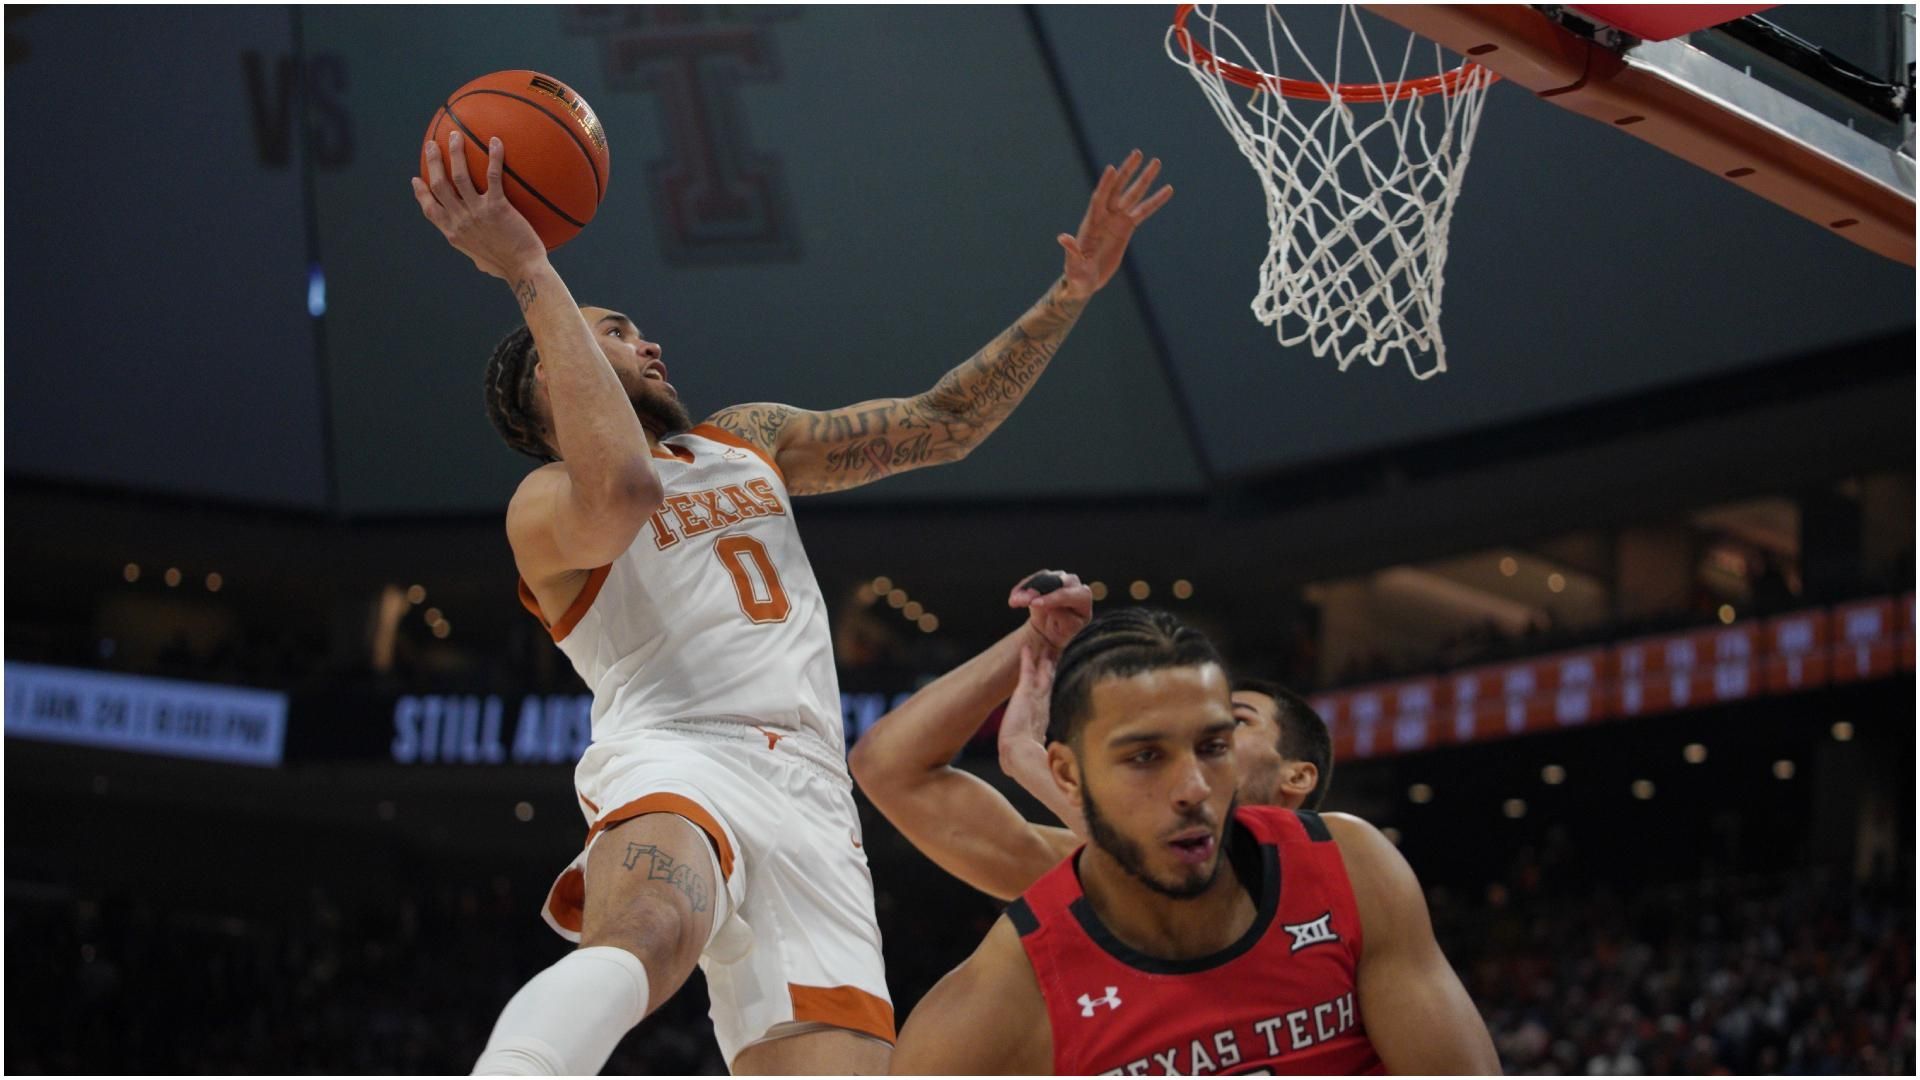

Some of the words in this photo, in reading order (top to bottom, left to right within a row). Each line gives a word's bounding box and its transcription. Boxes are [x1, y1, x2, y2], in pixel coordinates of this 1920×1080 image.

[649, 477, 787, 551] TEXAS
[713, 533, 792, 625] 0
[391, 694, 505, 764] STILL
[1284, 913, 1338, 951] XII
[1254, 991, 1355, 1056] TECH
